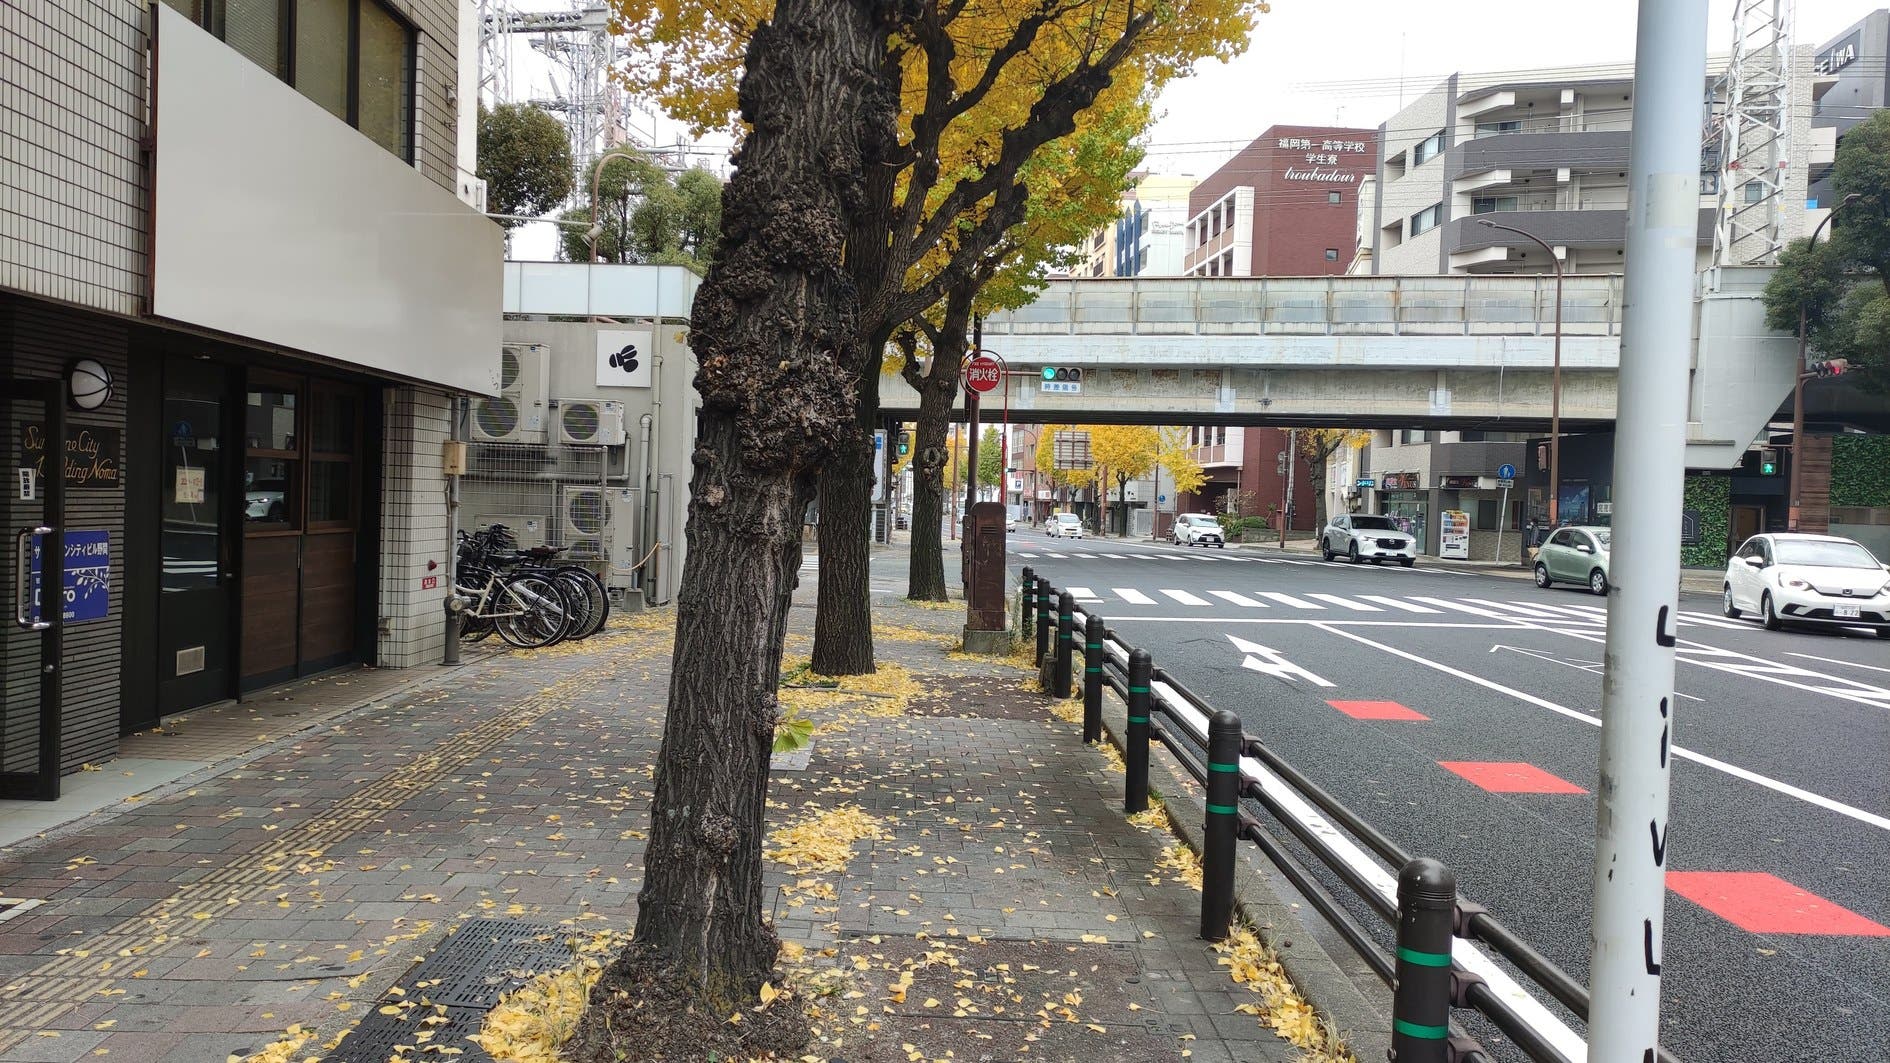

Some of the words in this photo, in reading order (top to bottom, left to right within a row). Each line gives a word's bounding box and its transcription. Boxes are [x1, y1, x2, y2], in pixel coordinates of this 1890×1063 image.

[1278, 138, 1366, 153] 福岡第一高等学校
[1305, 153, 1338, 165] 学生寮
[969, 368, 998, 382] 消火栓
[78, 430, 100, 460] City
